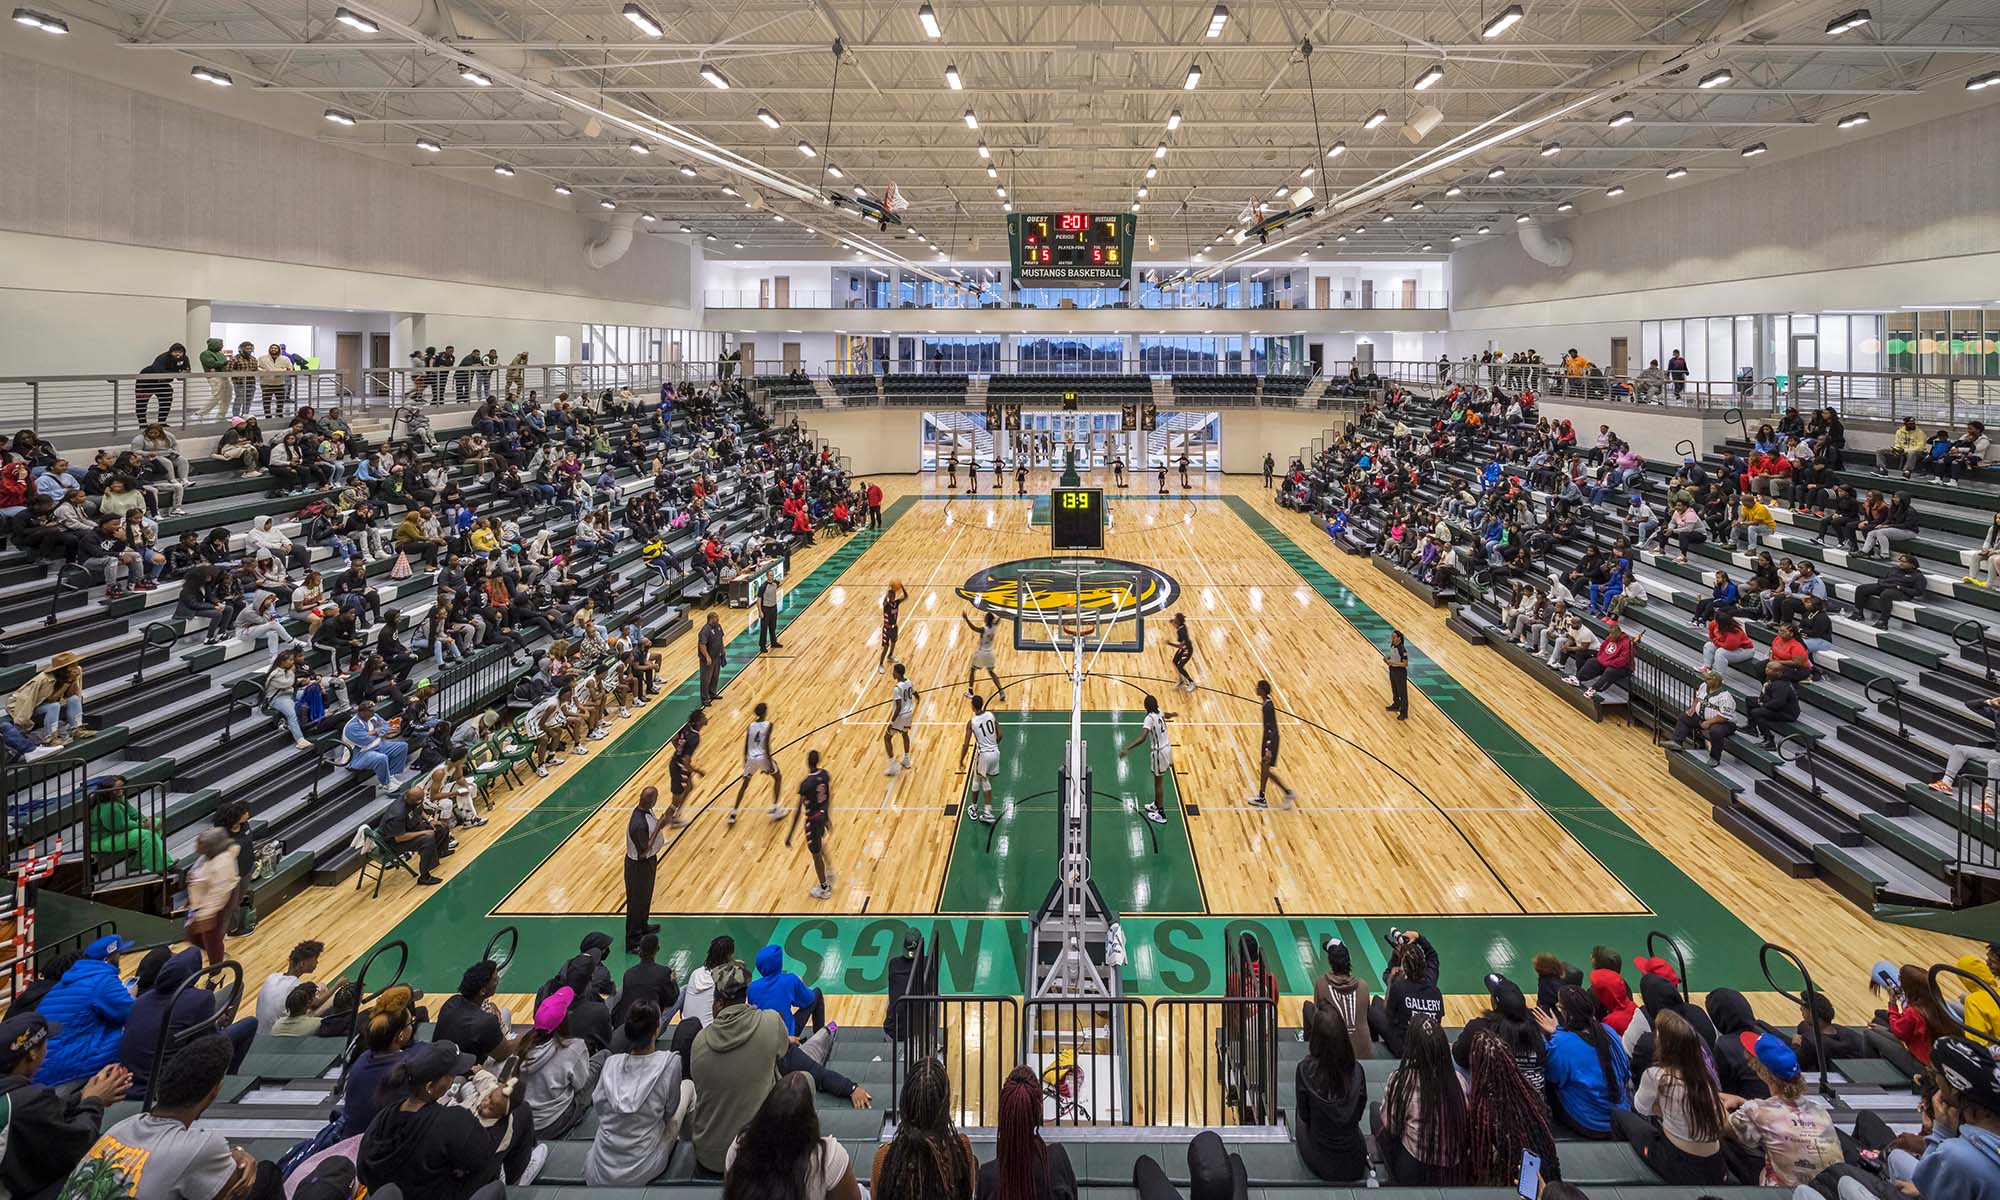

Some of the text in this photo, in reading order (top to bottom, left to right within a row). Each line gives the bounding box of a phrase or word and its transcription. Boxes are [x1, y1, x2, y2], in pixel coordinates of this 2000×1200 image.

[1062, 215, 1088, 229] 2:01
[1038, 222, 1048, 237] 7
[1106, 222, 1115, 237] 7
[1031, 249, 1037, 261] 1
[1042, 249, 1049, 261] 5
[1093, 249, 1101, 261] 5
[1108, 249, 1117, 261] 6
[1021, 268, 1121, 277] MUSTANGS BASKETBALL
[979, 719, 995, 737] 10
[754, 730, 761, 746] 4
[782, 918, 1386, 994] MUSNGS
[1405, 996, 1441, 1012] GALLERY
